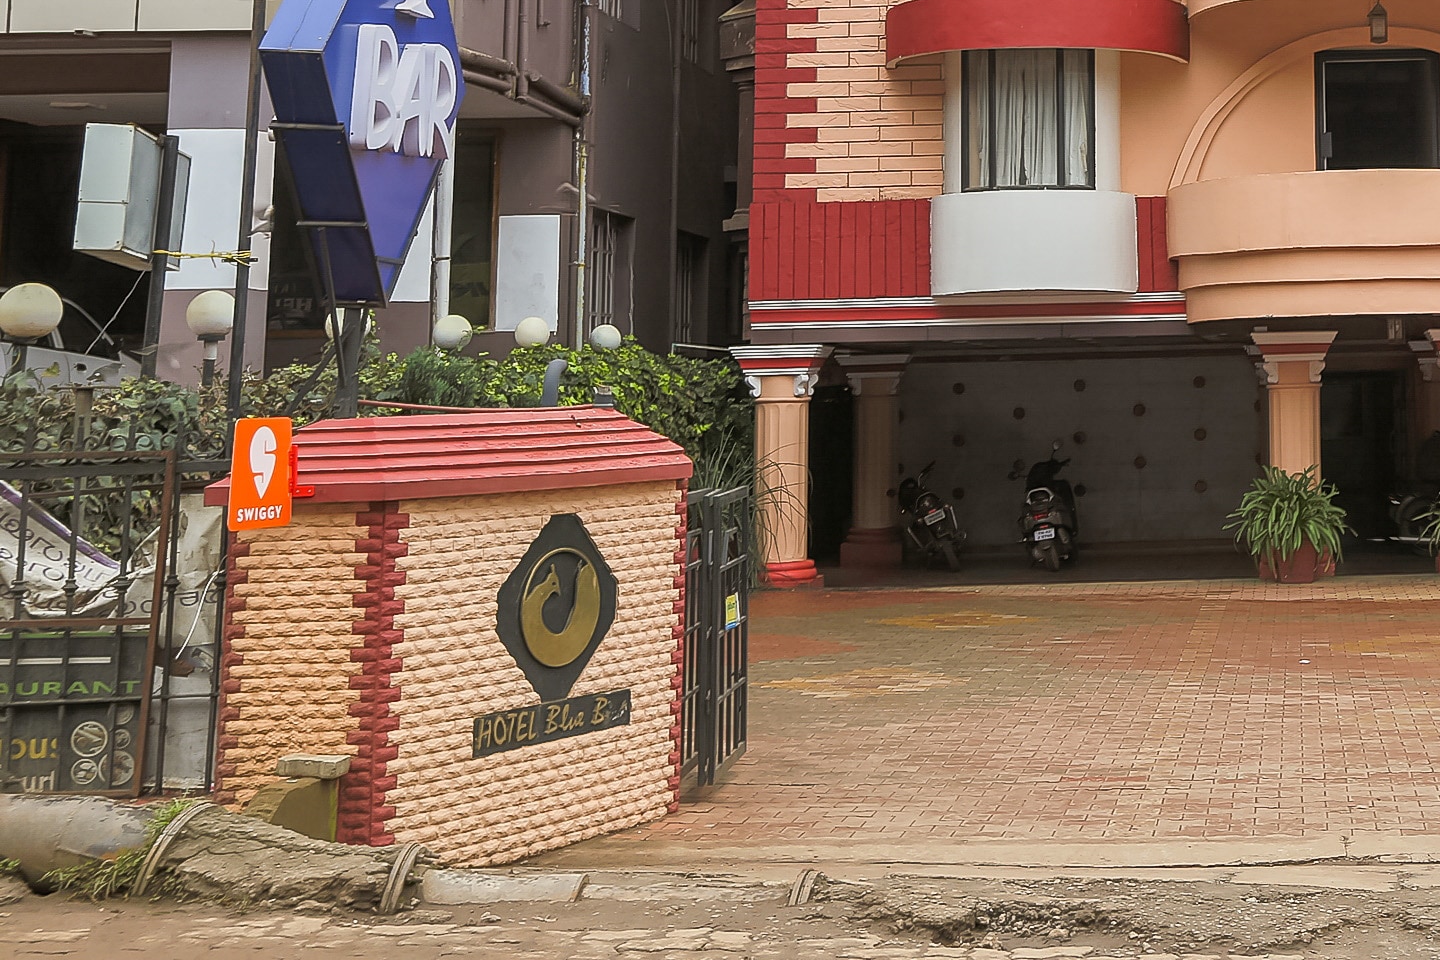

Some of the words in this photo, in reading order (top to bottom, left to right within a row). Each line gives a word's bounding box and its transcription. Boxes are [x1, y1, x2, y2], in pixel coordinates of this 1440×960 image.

[349, 24, 457, 160] BAR
[237, 505, 282, 522] SWIGGY
[476, 710, 539, 750] HOTEL
